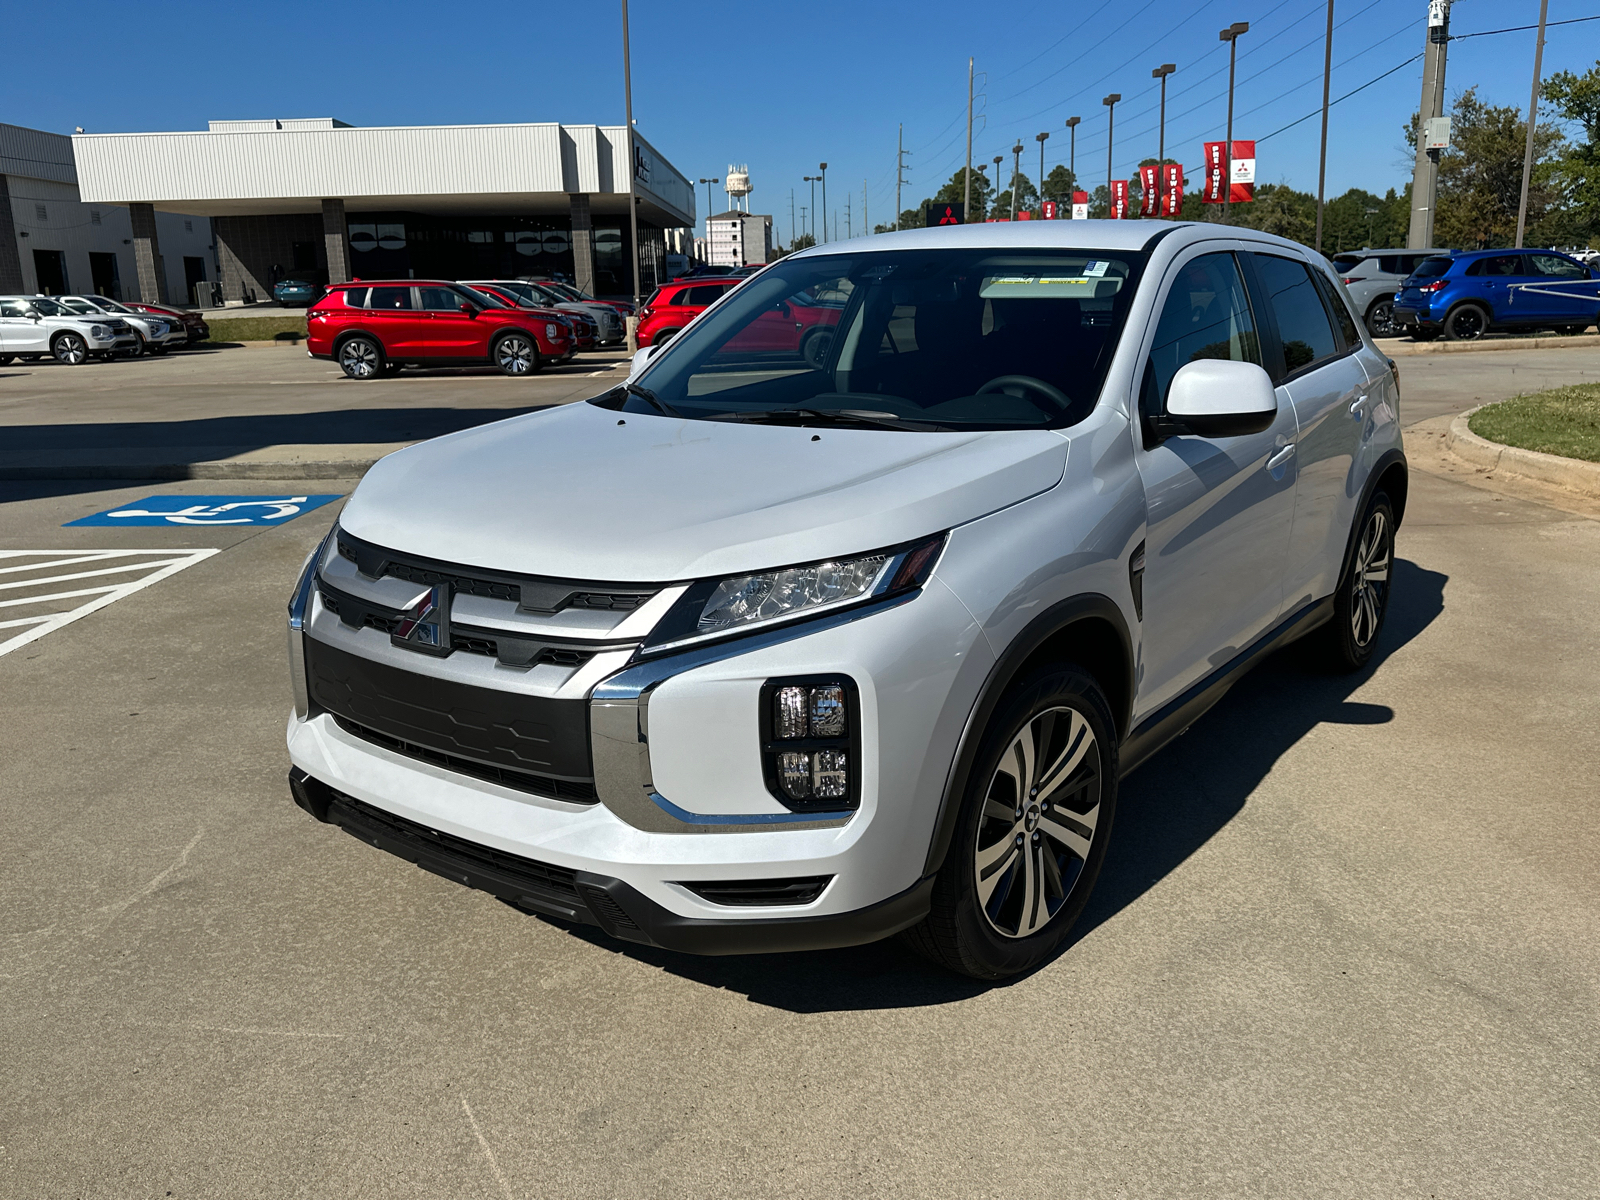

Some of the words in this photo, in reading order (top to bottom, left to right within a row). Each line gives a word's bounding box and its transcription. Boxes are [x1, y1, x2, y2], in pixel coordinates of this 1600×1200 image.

[1147, 169, 1155, 214] PRE-OWNED
[1169, 168, 1178, 187] NEW
[1211, 145, 1221, 199] PRE-OWNED
